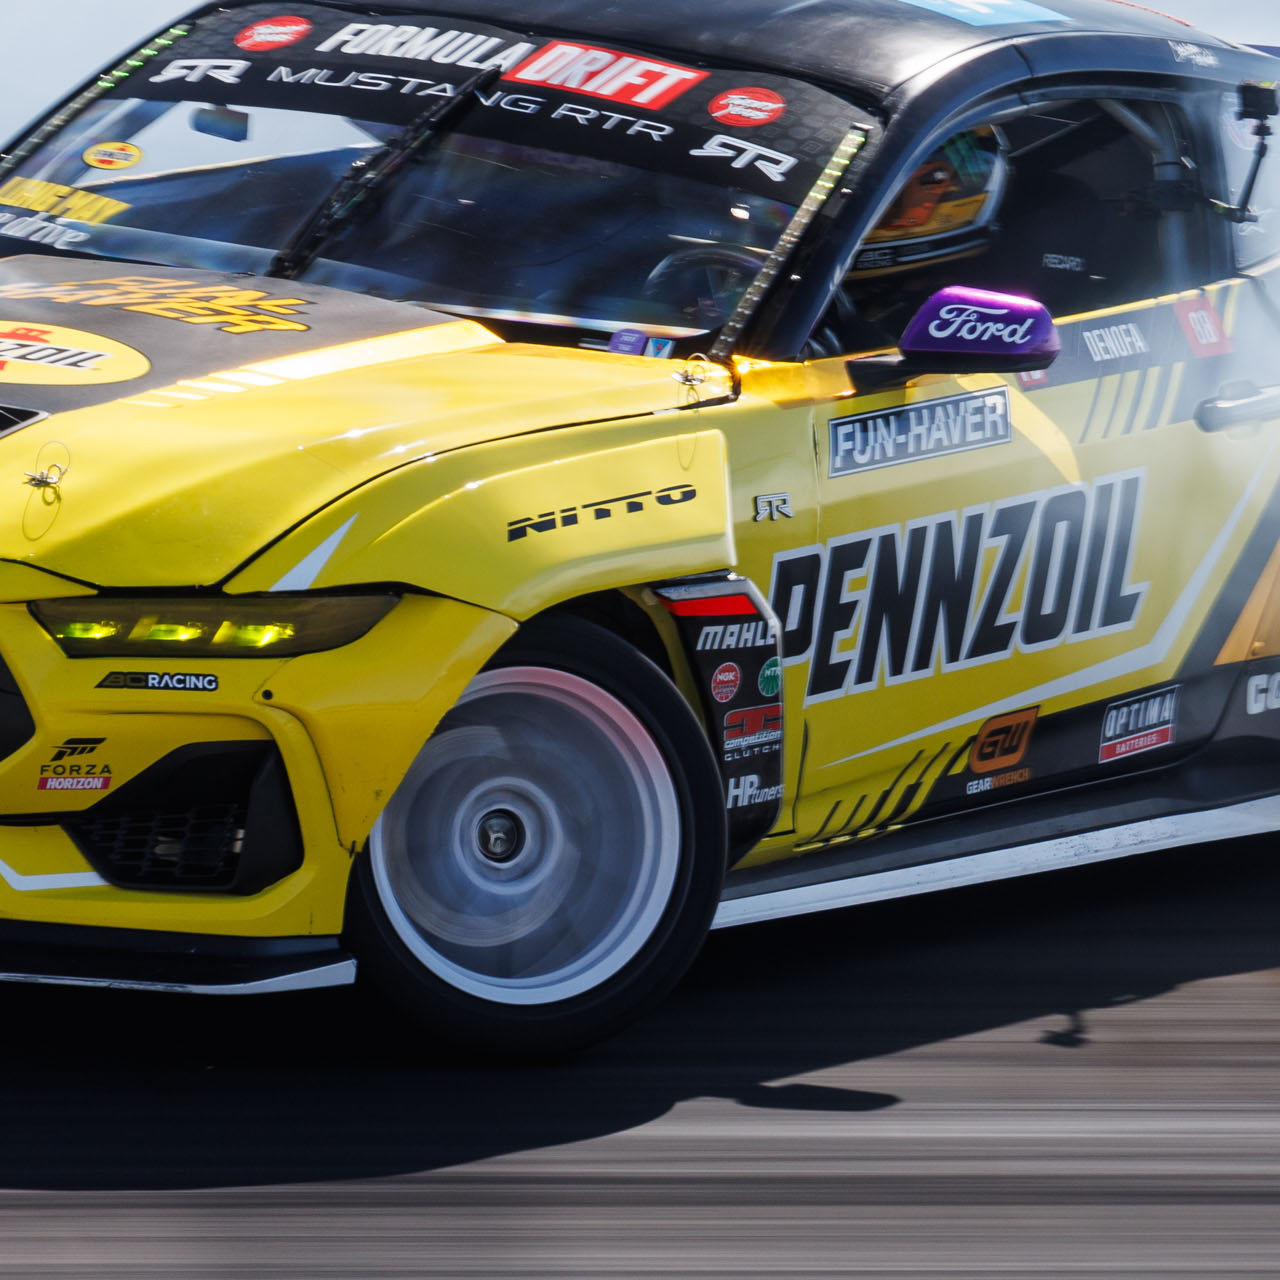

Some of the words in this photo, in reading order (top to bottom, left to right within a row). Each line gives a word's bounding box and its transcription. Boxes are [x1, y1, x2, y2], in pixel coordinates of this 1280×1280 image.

[314, 23, 538, 72] FORMULA
[514, 44, 701, 104] DRIFT
[266, 66, 547, 114] MUSTANG
[550, 103, 675, 142] RTR
[928, 304, 1035, 345] Ford
[1082, 323, 1150, 362] DENOFA
[834, 394, 1007, 468] FUN-HAVER
[507, 484, 697, 542] NITTO
[775, 468, 1151, 709] PENNZOIL
[696, 621, 778, 651] MAHLE
[717, 672, 735, 682] NGK
[1105, 692, 1177, 738] OPTIMA
[724, 730, 782, 750] competition
[725, 744, 780, 761] CLUTCH
[1115, 733, 1157, 754] BATTERIES
[40, 765, 112, 775] FORZA
[46, 777, 104, 789] HORIZON
